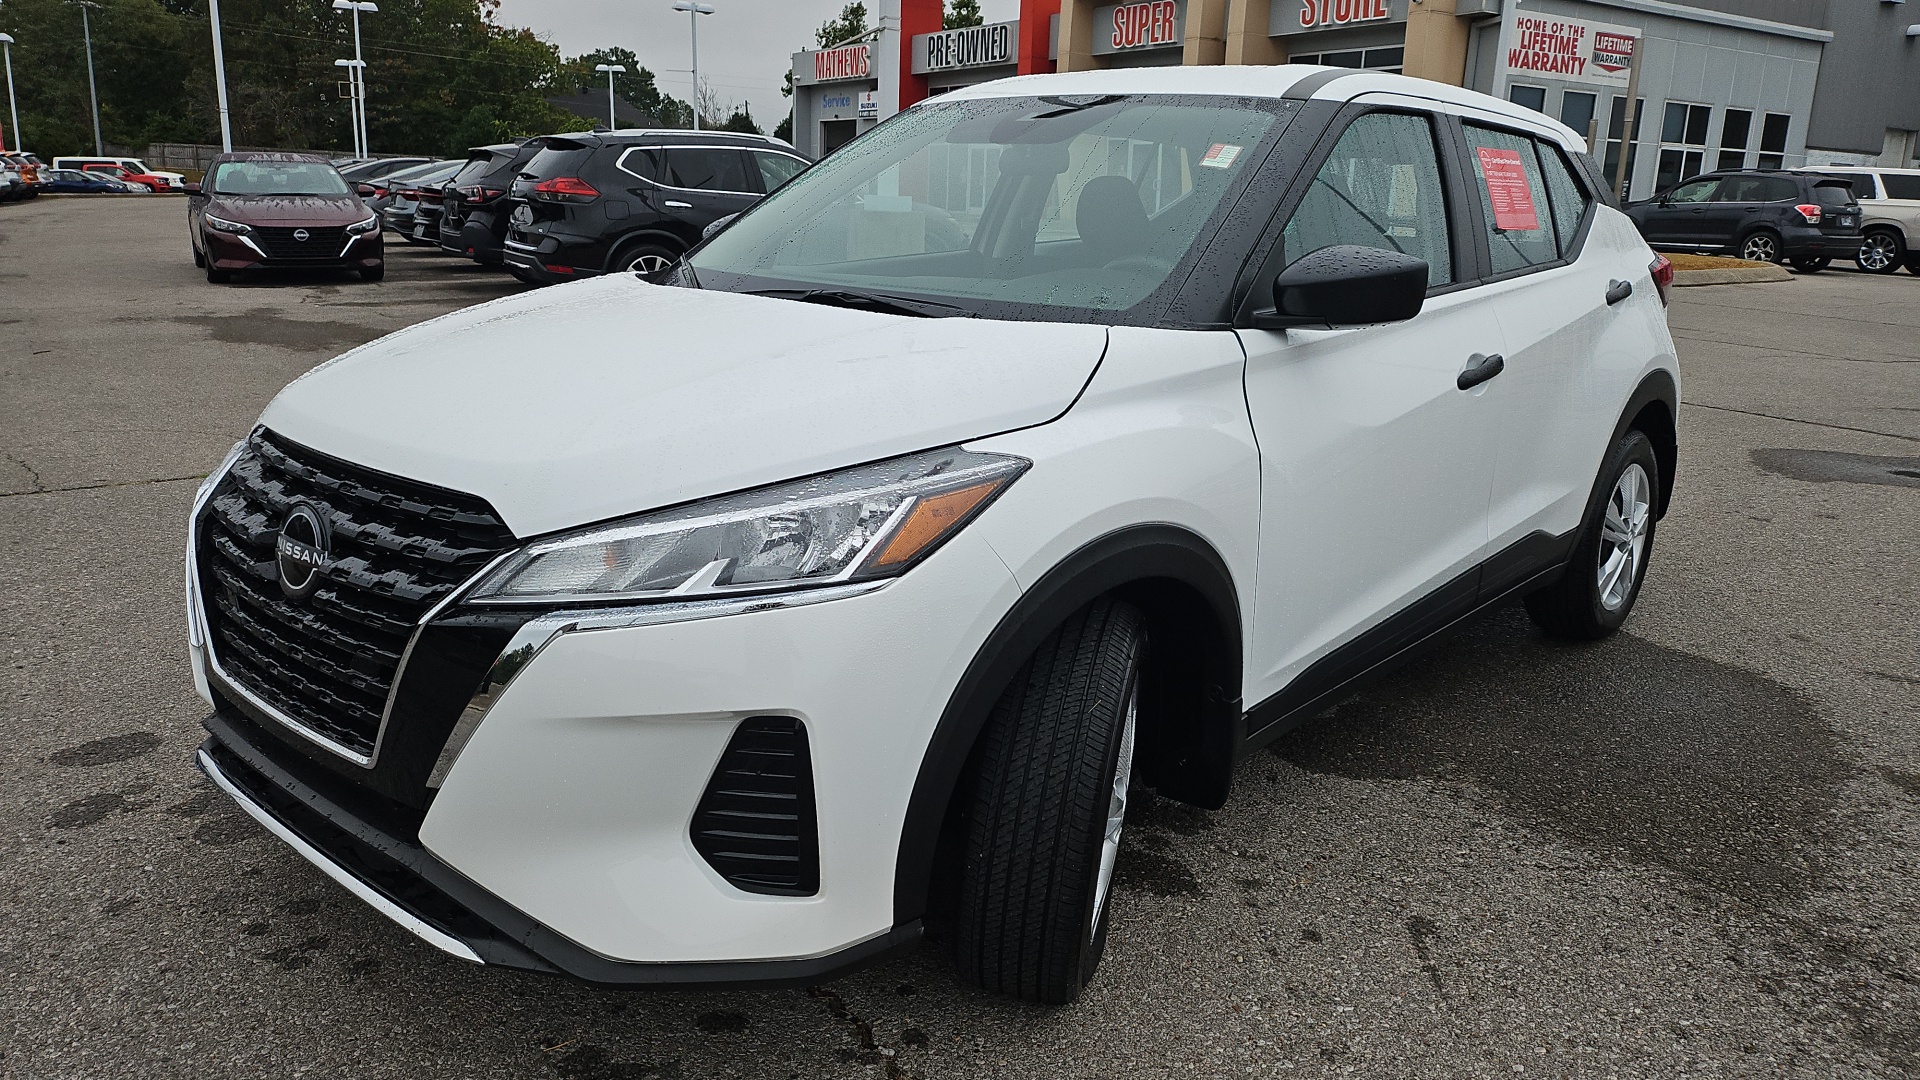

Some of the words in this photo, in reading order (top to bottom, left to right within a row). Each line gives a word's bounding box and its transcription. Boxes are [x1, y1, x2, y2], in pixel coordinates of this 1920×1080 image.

[1112, 0, 1175, 48] SUPER
[1517, 17, 1547, 32] HOME
[1551, 22, 1565, 34] OF
[1568, 25, 1585, 38] THE
[926, 24, 1009, 68] PRE-OWNED
[1520, 30, 1579, 56] LIFETIME
[1595, 35, 1633, 53] LIFETIME
[815, 45, 868, 80] MATHEWS
[1508, 48, 1587, 75] WARRANTY
[1594, 52, 1632, 67] WARRANTY
[823, 94, 850, 109] Service
[278, 536, 323, 566] NISSAN
